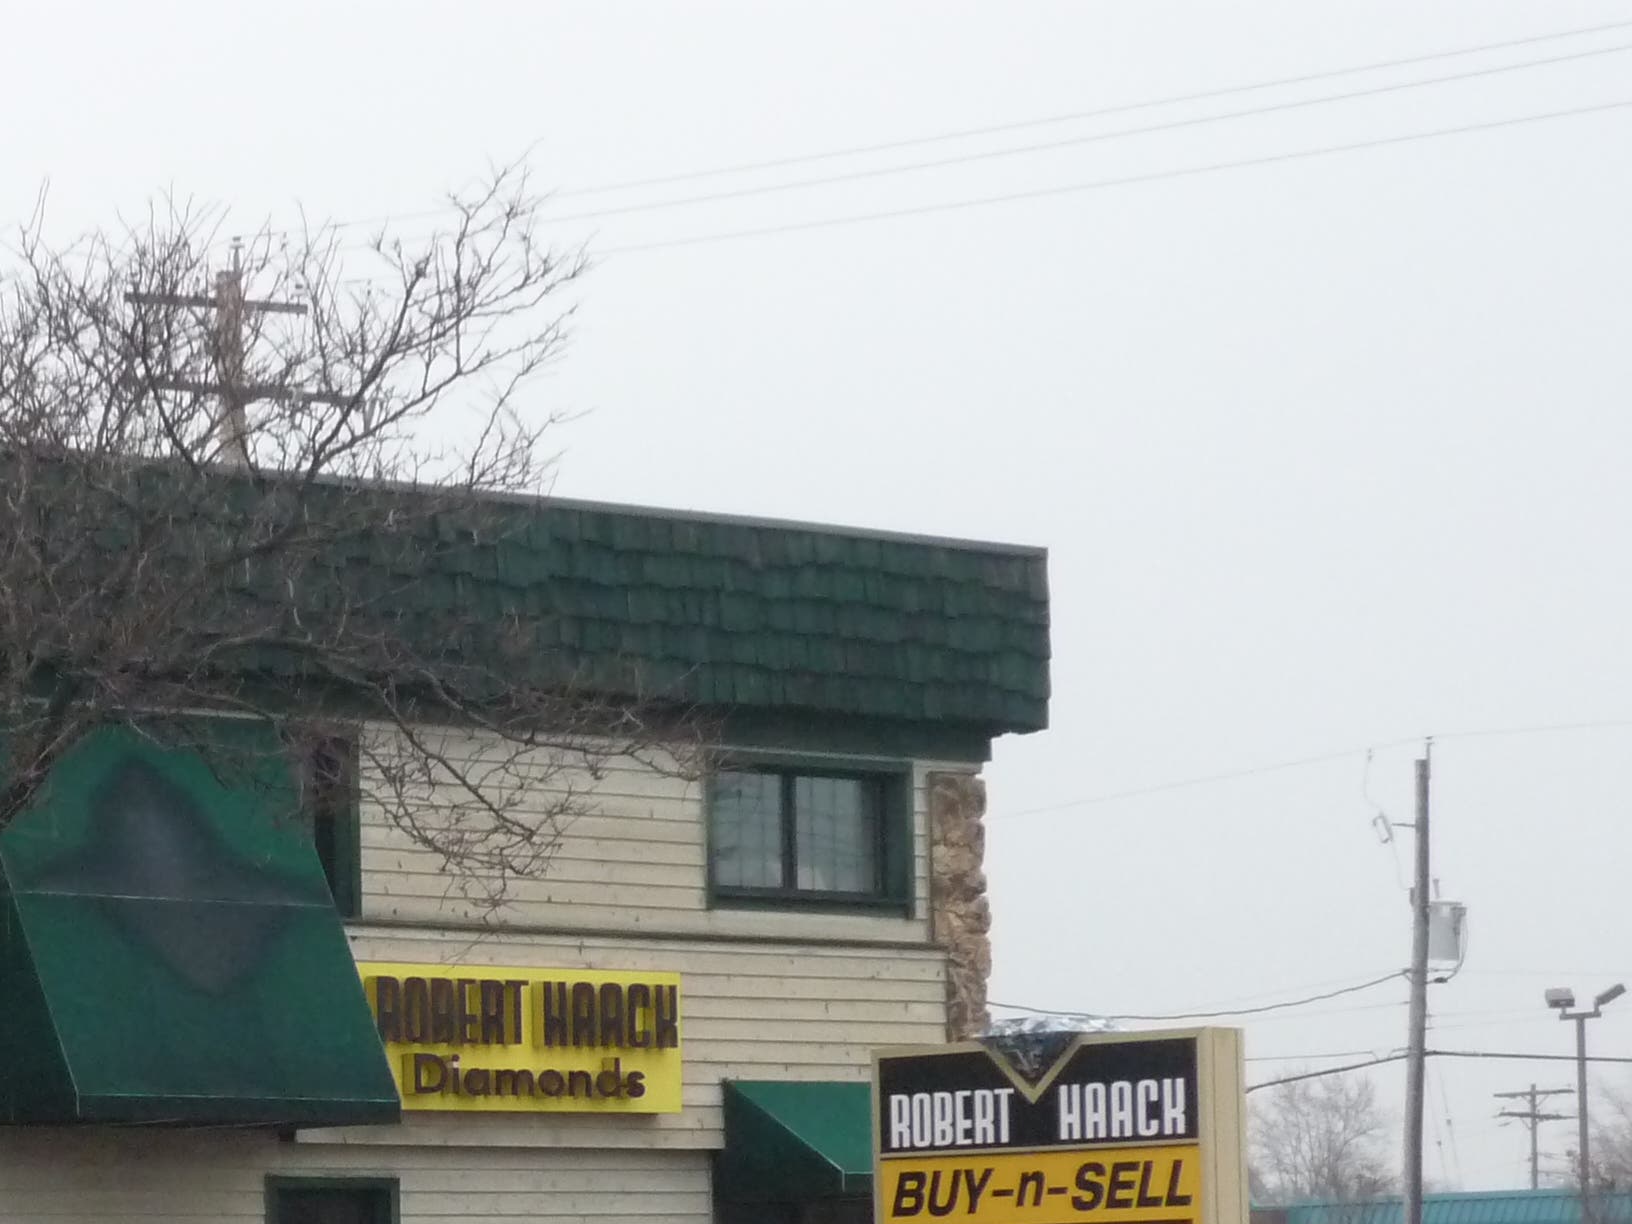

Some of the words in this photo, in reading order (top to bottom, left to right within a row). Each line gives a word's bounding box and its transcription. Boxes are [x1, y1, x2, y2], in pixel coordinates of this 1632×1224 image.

[366, 975, 529, 1045] ROBERT
[533, 980, 678, 1049] HAACK
[402, 1053, 646, 1098] Diamonds
[890, 1088, 1014, 1148] ROBERT
[1057, 1078, 1186, 1140] HAACK
[892, 1159, 1193, 1217] BUY-n-SELL
